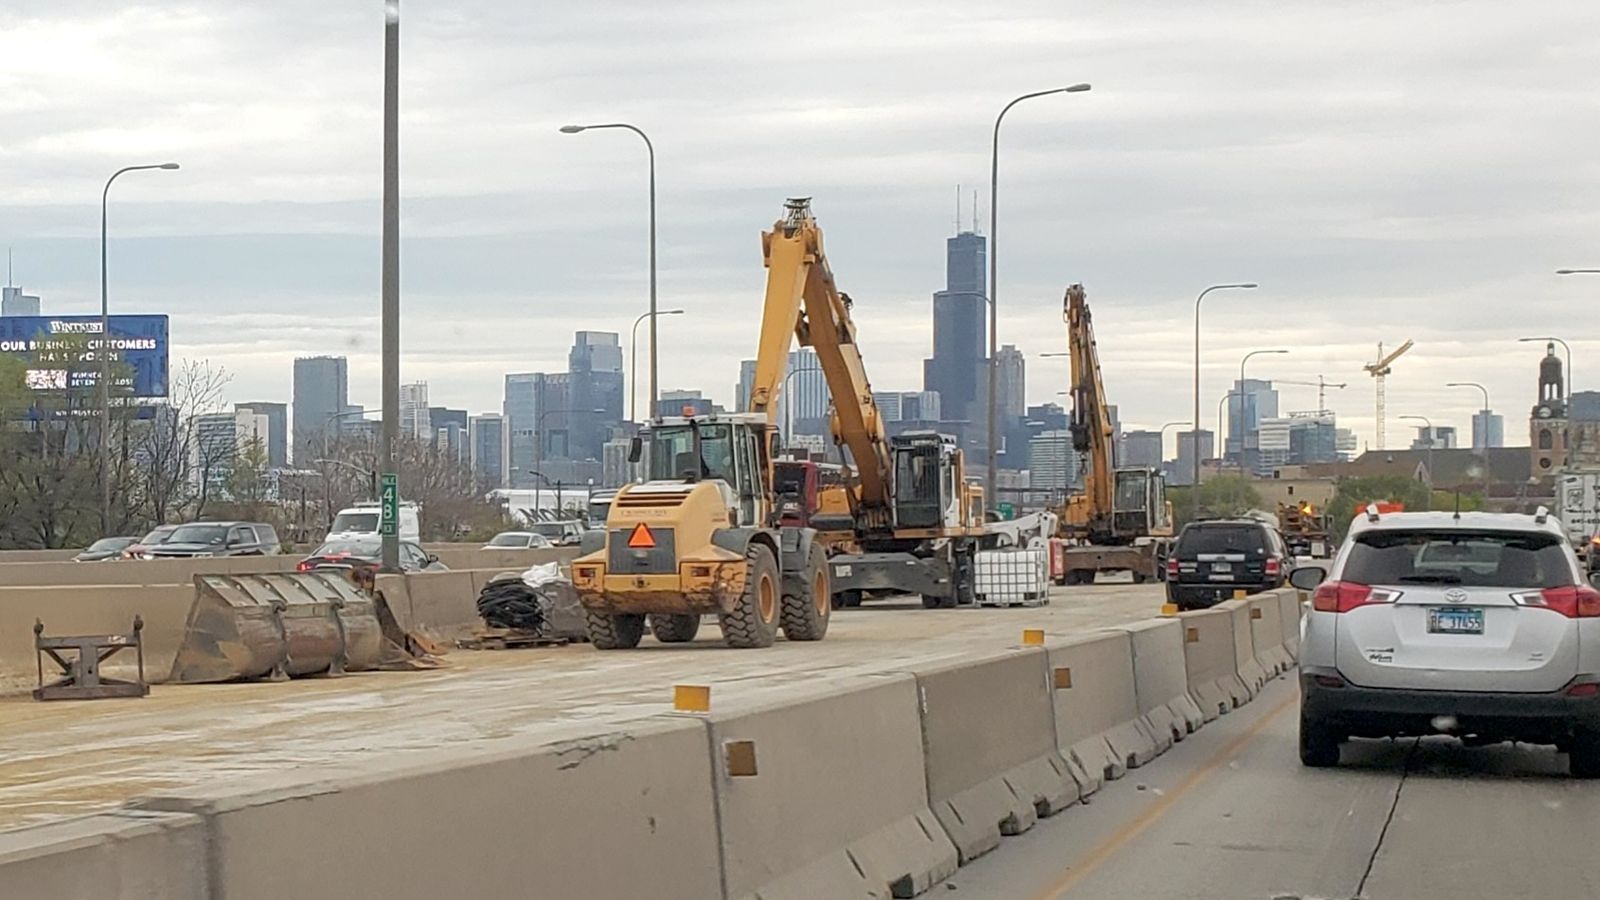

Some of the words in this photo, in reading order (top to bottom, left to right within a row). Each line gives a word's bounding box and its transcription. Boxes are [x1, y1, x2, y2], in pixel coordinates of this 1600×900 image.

[1, 341, 27, 351] OUR
[30, 340, 84, 351] BUSINE
[87, 339, 156, 350] CUTOMERS
